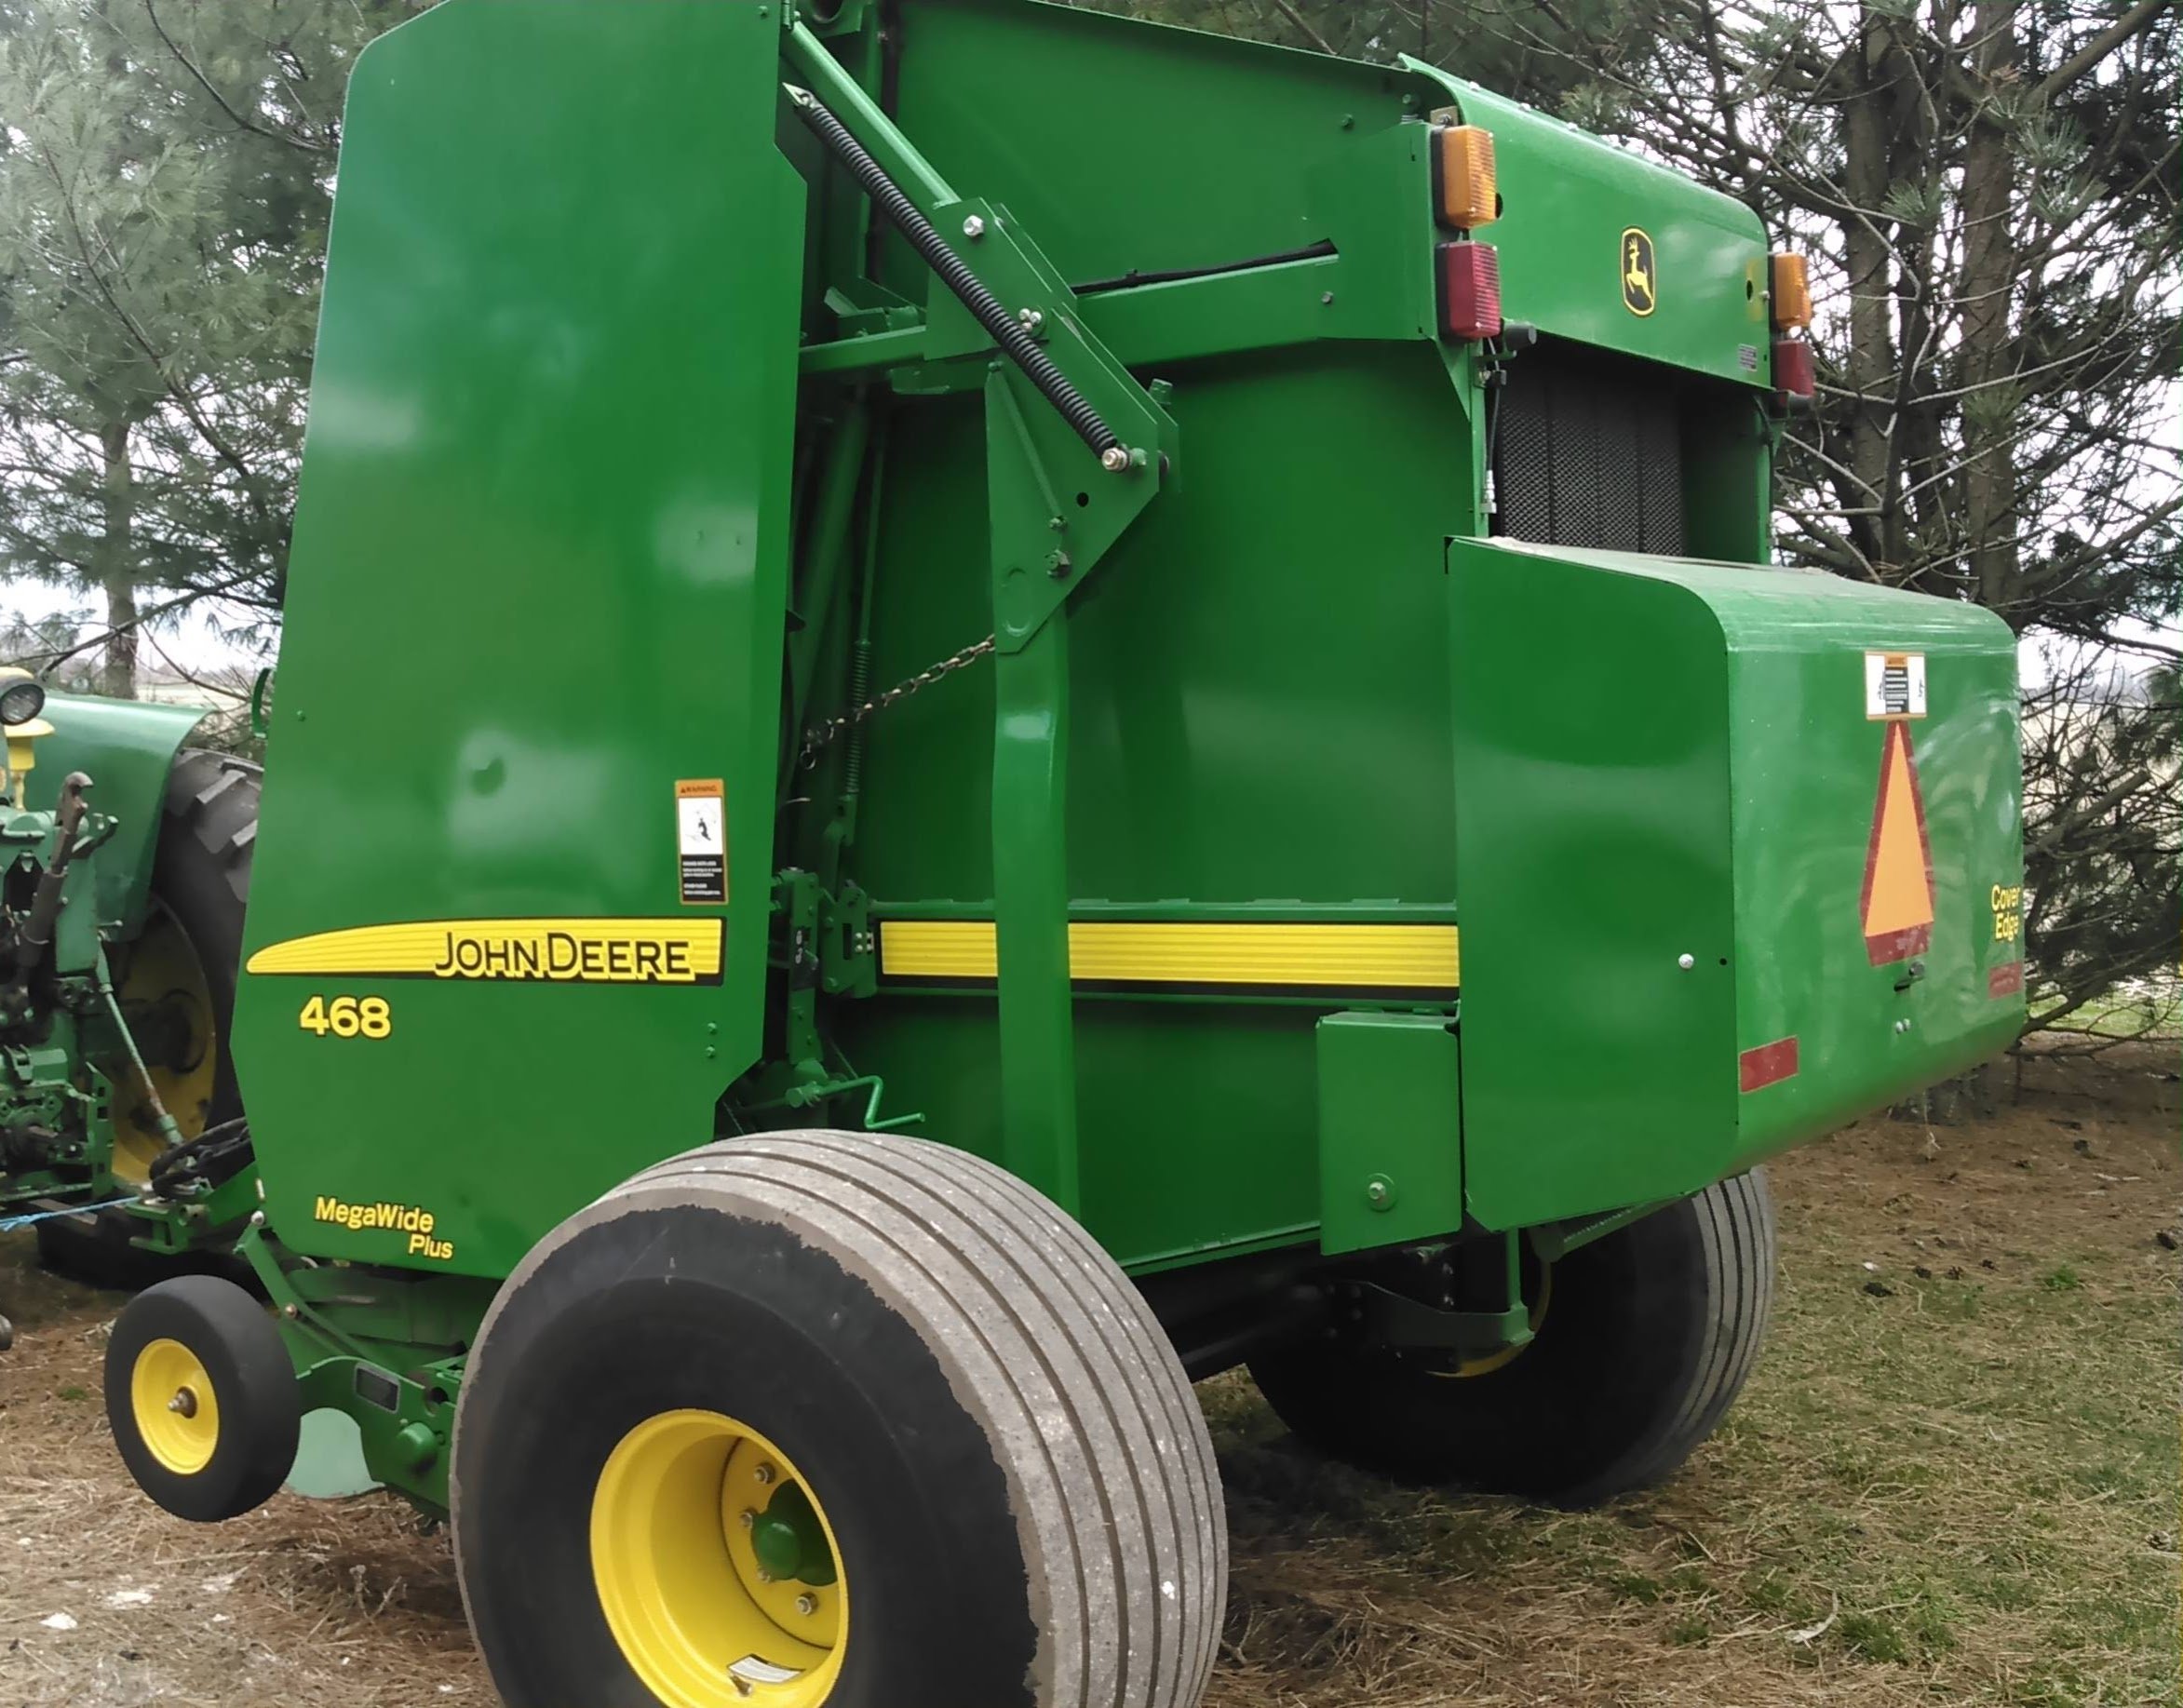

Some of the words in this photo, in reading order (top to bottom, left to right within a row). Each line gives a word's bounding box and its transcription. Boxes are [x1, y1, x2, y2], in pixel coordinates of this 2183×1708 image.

[1991, 884, 2020, 911] Cover
[1995, 912, 2019, 942] Edge
[435, 931, 541, 974] JOHN
[546, 932, 693, 976] DEERE
[299, 995, 392, 1038] 468
[315, 1196, 435, 1233] MegaWide
[408, 1233, 454, 1259] Plus
